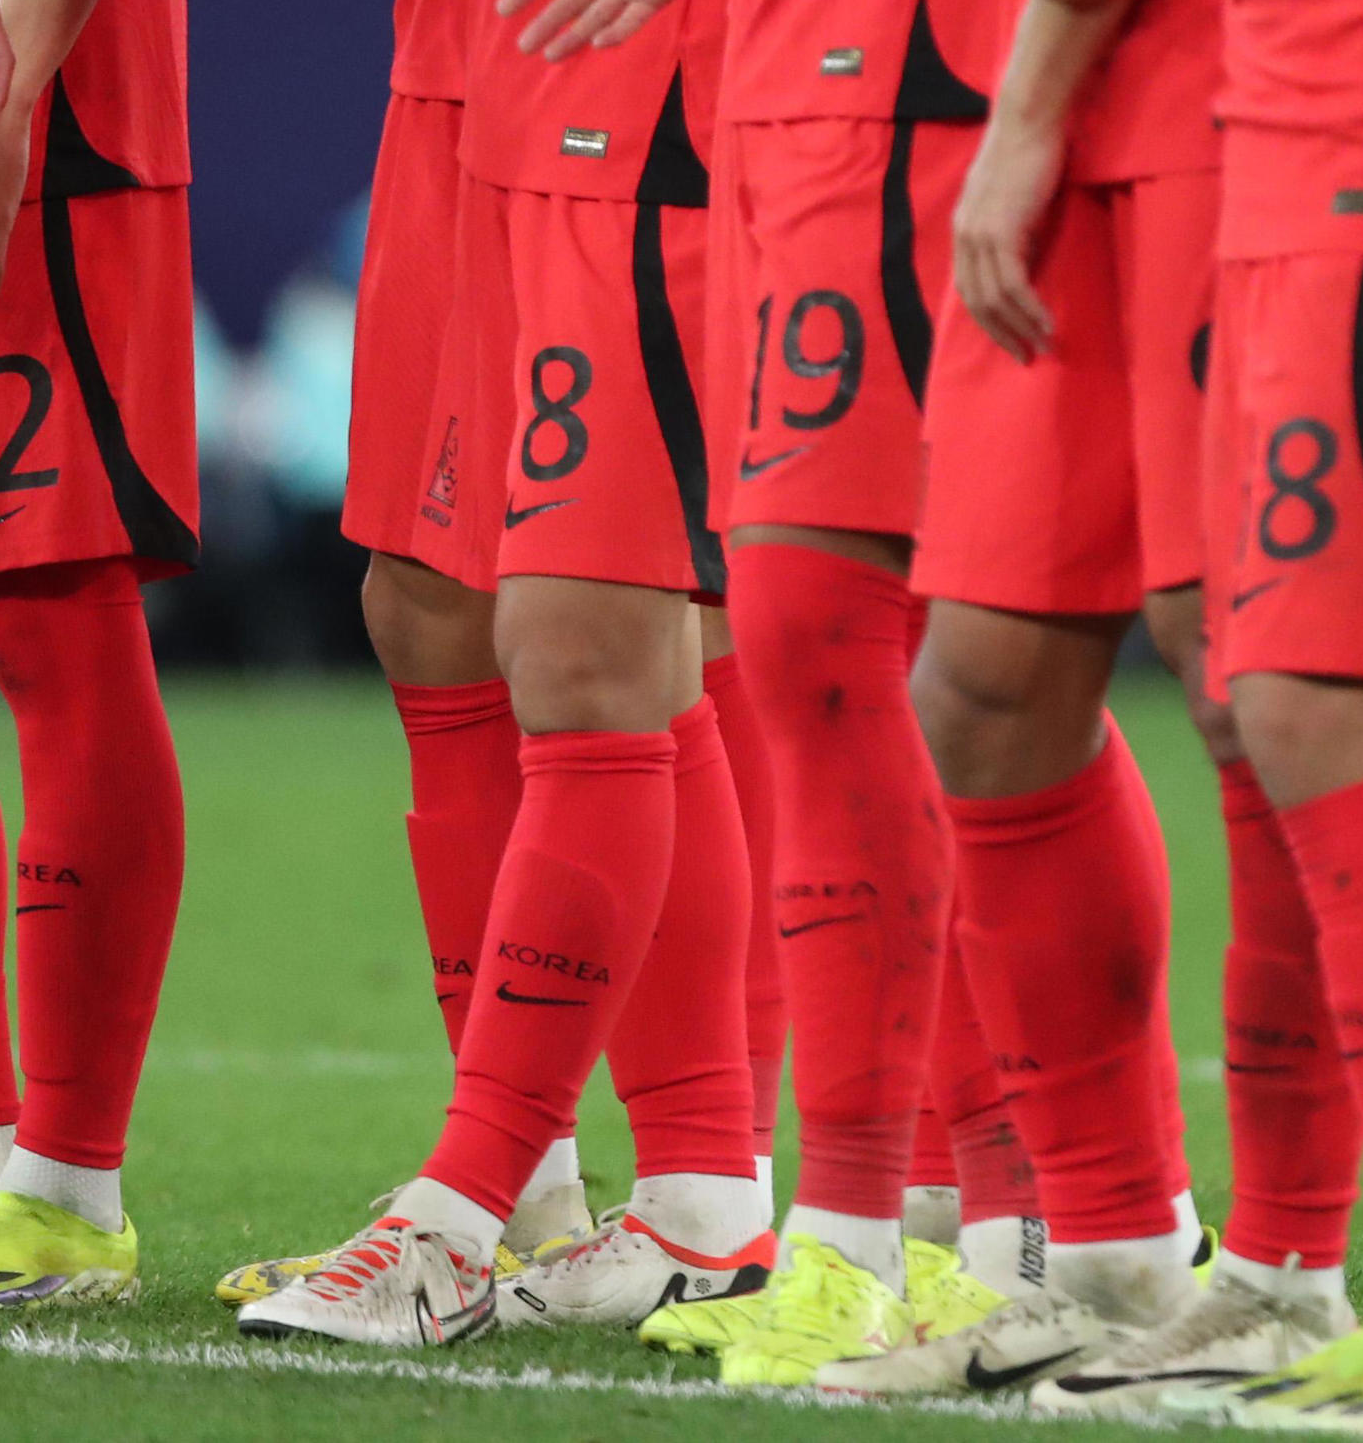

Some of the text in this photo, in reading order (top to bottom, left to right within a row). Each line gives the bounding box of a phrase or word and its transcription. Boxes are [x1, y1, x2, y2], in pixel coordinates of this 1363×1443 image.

[521, 345, 593, 482] 8
[748, 289, 866, 431] 19
[1242, 416, 1339, 562] 8
[498, 940, 610, 987] KOREA
